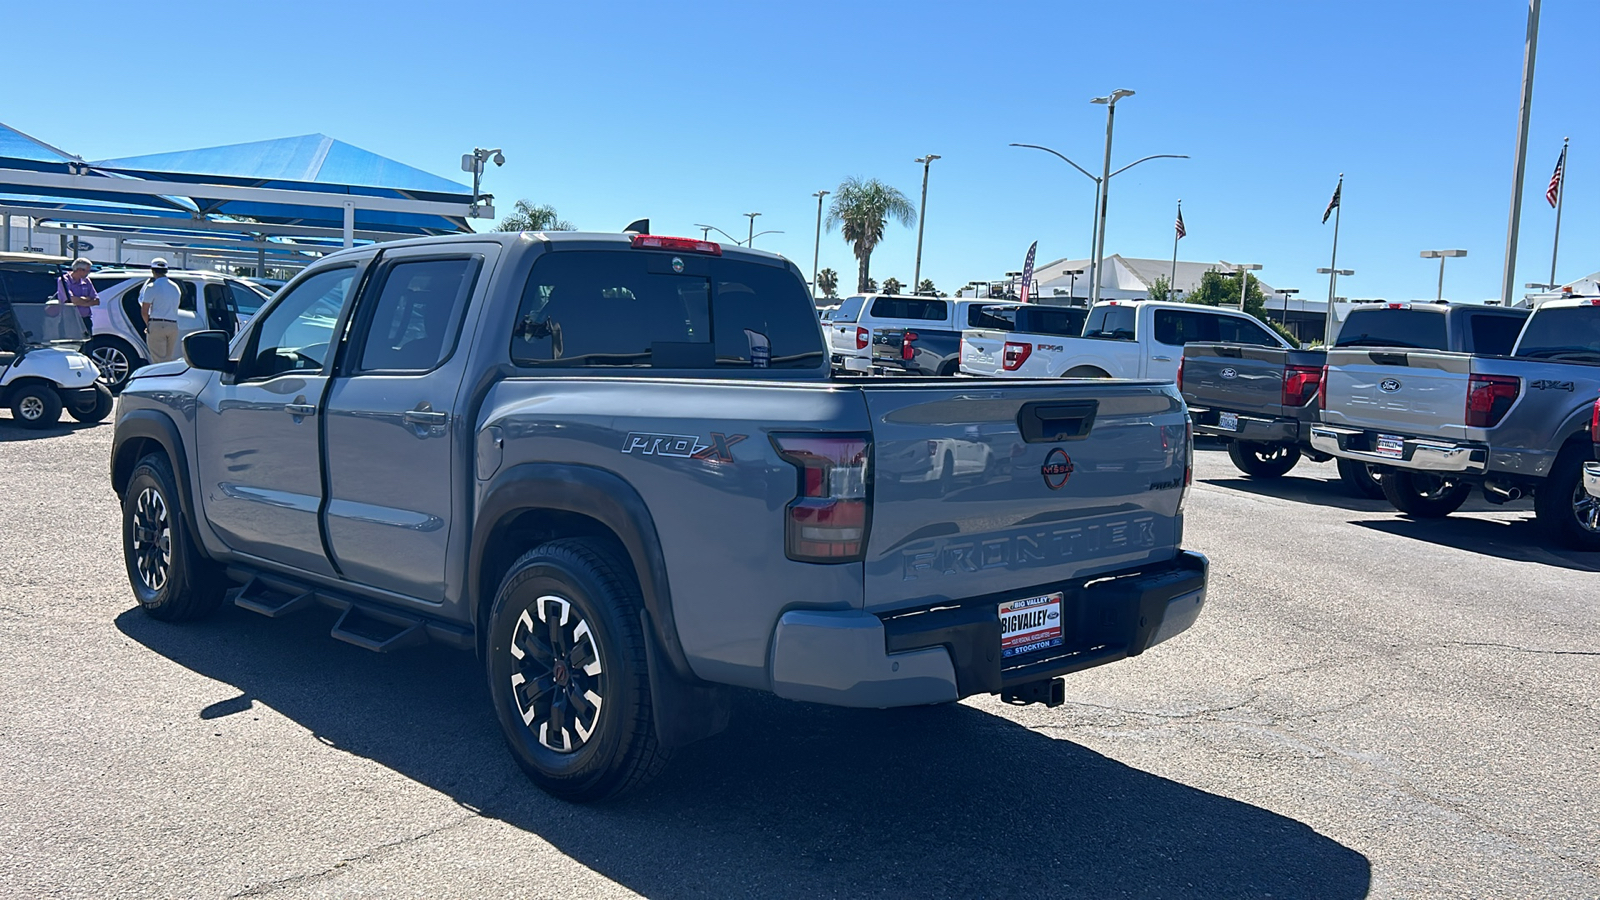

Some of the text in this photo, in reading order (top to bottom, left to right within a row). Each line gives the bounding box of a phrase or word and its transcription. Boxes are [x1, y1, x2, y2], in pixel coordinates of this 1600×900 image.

[1037, 344, 1064, 352] FX4
[1382, 380, 1399, 391] Ford
[1042, 464, 1074, 475] NISSAN
[901, 516, 1155, 582] FRONTIER
[1014, 596, 1048, 608] BIG VALLEY
[1002, 608, 1048, 634] BIGVALLEY
[1014, 640, 1050, 654] STOCKTON
